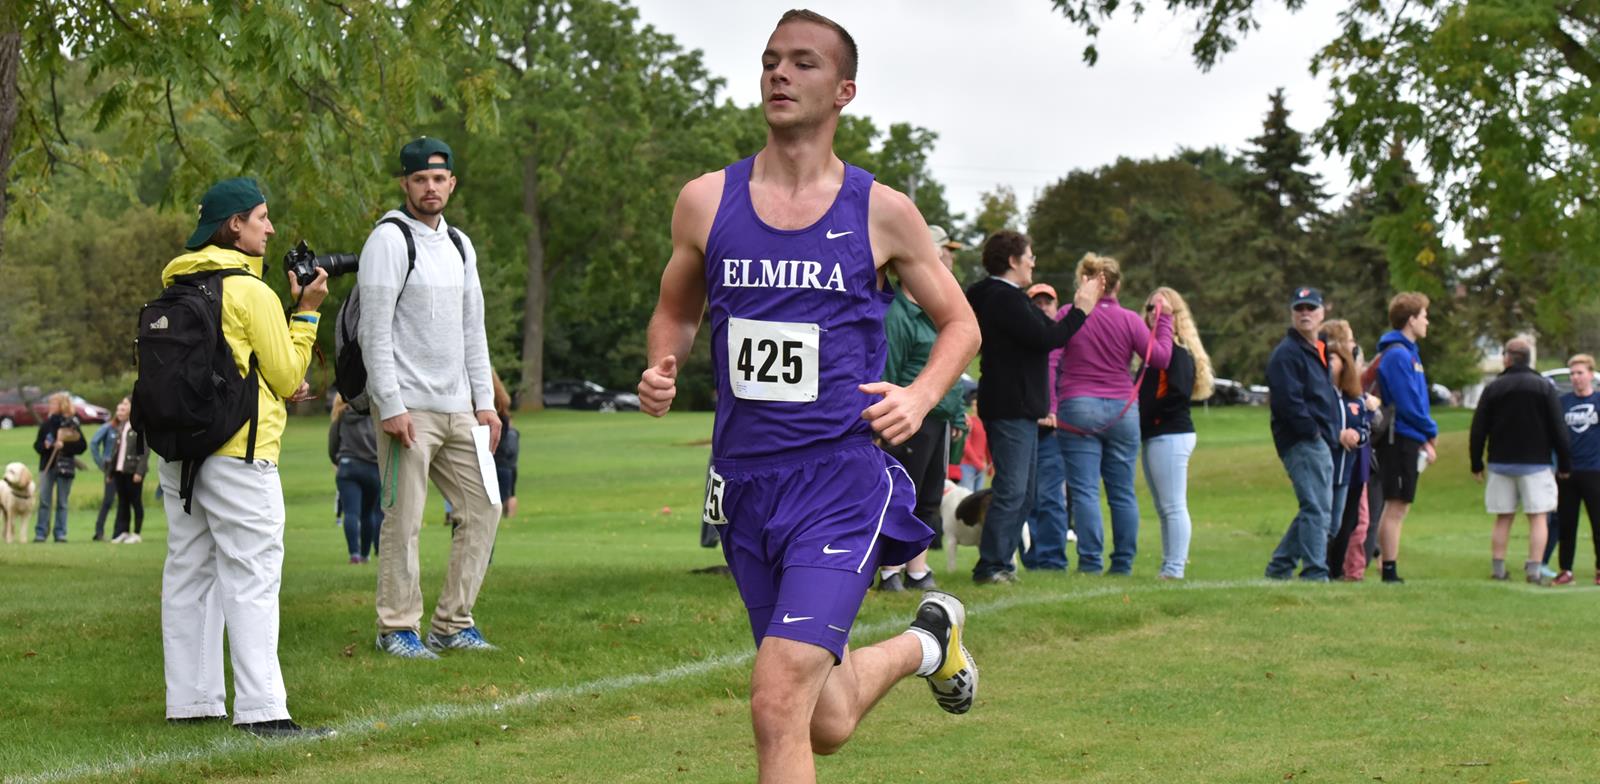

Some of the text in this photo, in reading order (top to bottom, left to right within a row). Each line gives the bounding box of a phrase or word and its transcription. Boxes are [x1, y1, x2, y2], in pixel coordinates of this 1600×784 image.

[722, 258, 847, 292] ELMIRA
[736, 337, 804, 385] 425
[705, 478, 721, 521] 5
